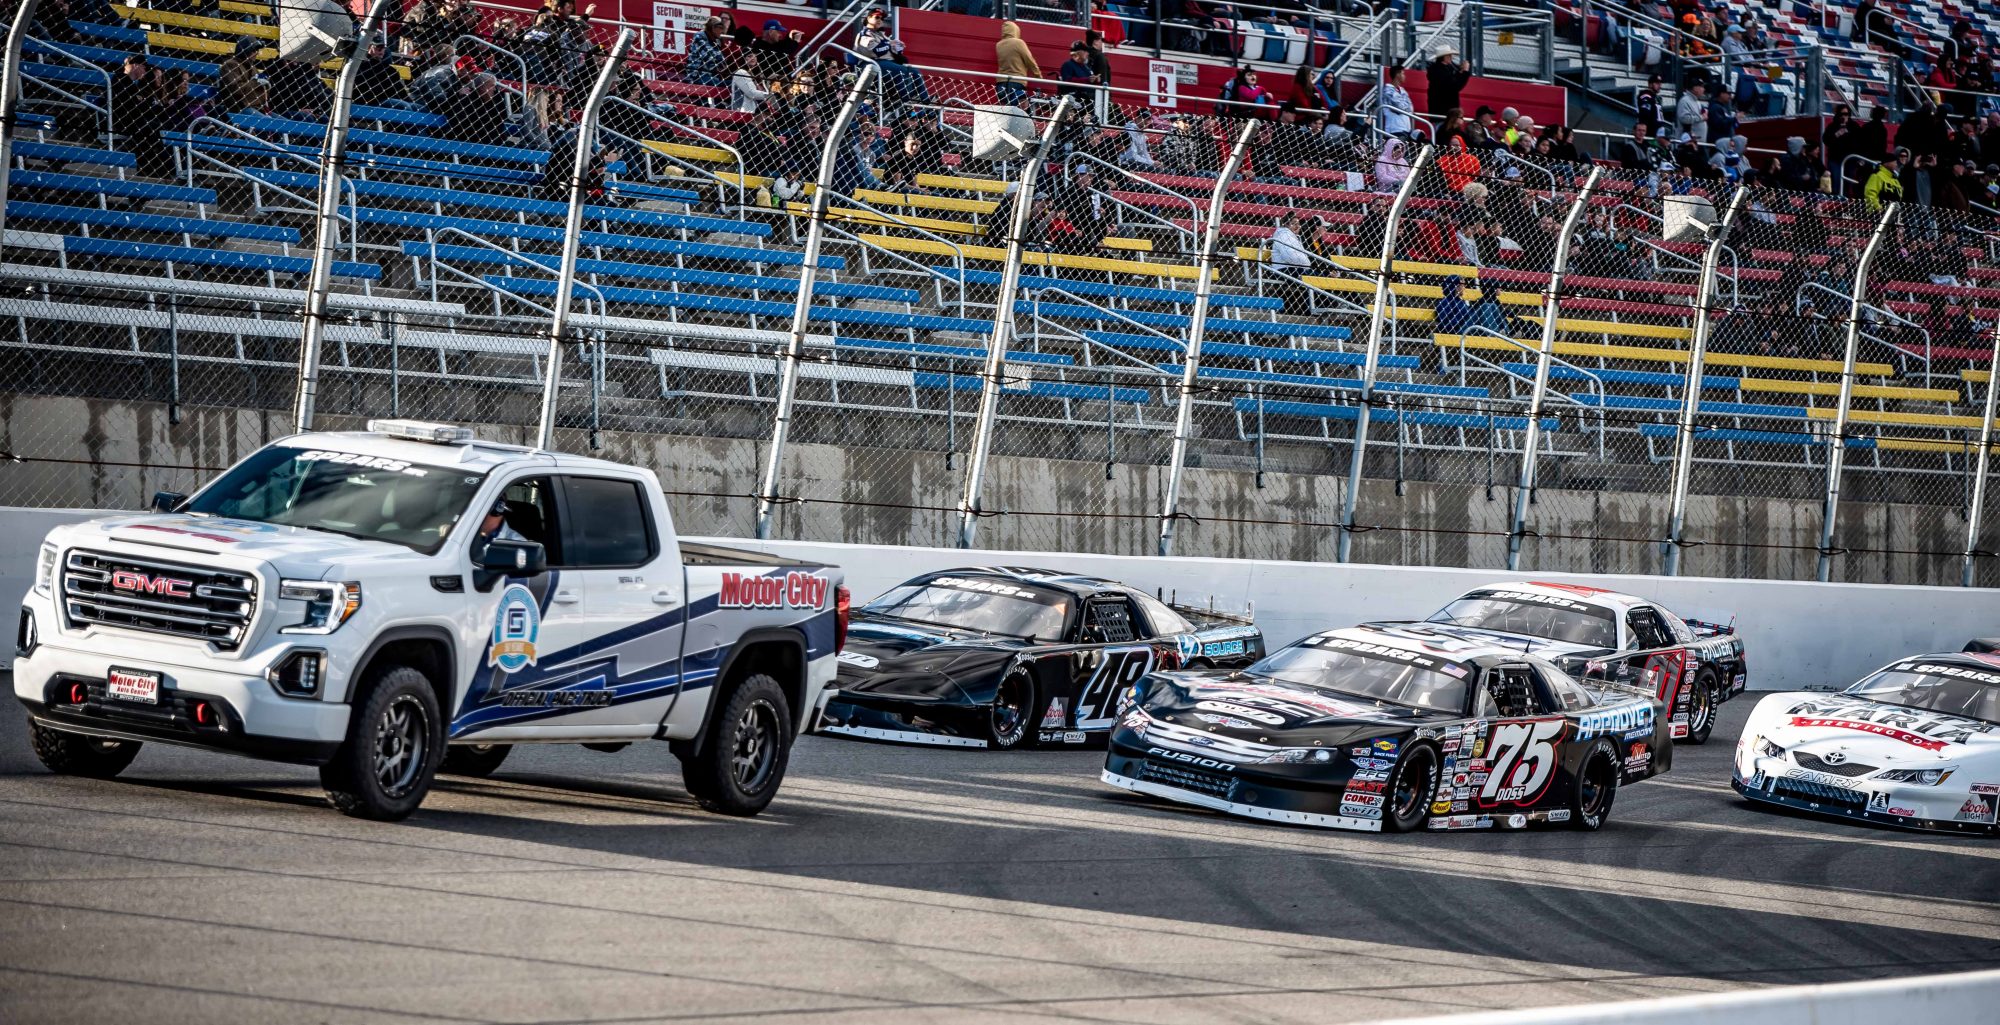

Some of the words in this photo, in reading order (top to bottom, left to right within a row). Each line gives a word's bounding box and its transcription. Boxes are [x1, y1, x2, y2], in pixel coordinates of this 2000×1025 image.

[656, 5, 683, 18] SECTION
[663, 20, 676, 49] A
[1152, 63, 1174, 75] SECTION
[1157, 75, 1169, 103] B
[295, 450, 412, 472] SPEARS
[112, 569, 193, 599] GMC
[719, 572, 785, 607] Motor
[786, 570, 829, 612] City
[930, 577, 1021, 595] SPEARS
[1490, 591, 1575, 607] SPEARS
[1204, 640, 1244, 657] SOURCE
[1324, 639, 1420, 661] SPEARS
[1914, 664, 2000, 684] SPEARS
[110, 675, 136, 687] Motor
[137, 678, 156, 692] City
[130, 688, 149, 696] Center
[1077, 645, 1152, 730] 48
[502, 690, 548, 707] OFFICIAL
[549, 690, 579, 707] PACE
[577, 690, 617, 706] TRUCK
[1575, 701, 1654, 741] APPROVED
[1786, 702, 1975, 745] MARIA
[1065, 732, 1084, 740] Swift
[1811, 720, 1896, 736] BREWING
[1902, 734, 1923, 745] CO
[1147, 748, 1236, 771] FUSION
[1481, 720, 1564, 798] 75
[1624, 752, 1651, 765] UNLIMITED
[1347, 779, 1387, 793] FAST
[1785, 769, 1862, 789] CAMRY
[1345, 794, 1374, 805] COMP
[1496, 787, 1525, 801] DOSS
[1343, 806, 1379, 815] Swift
[1961, 799, 1992, 814] Coors
